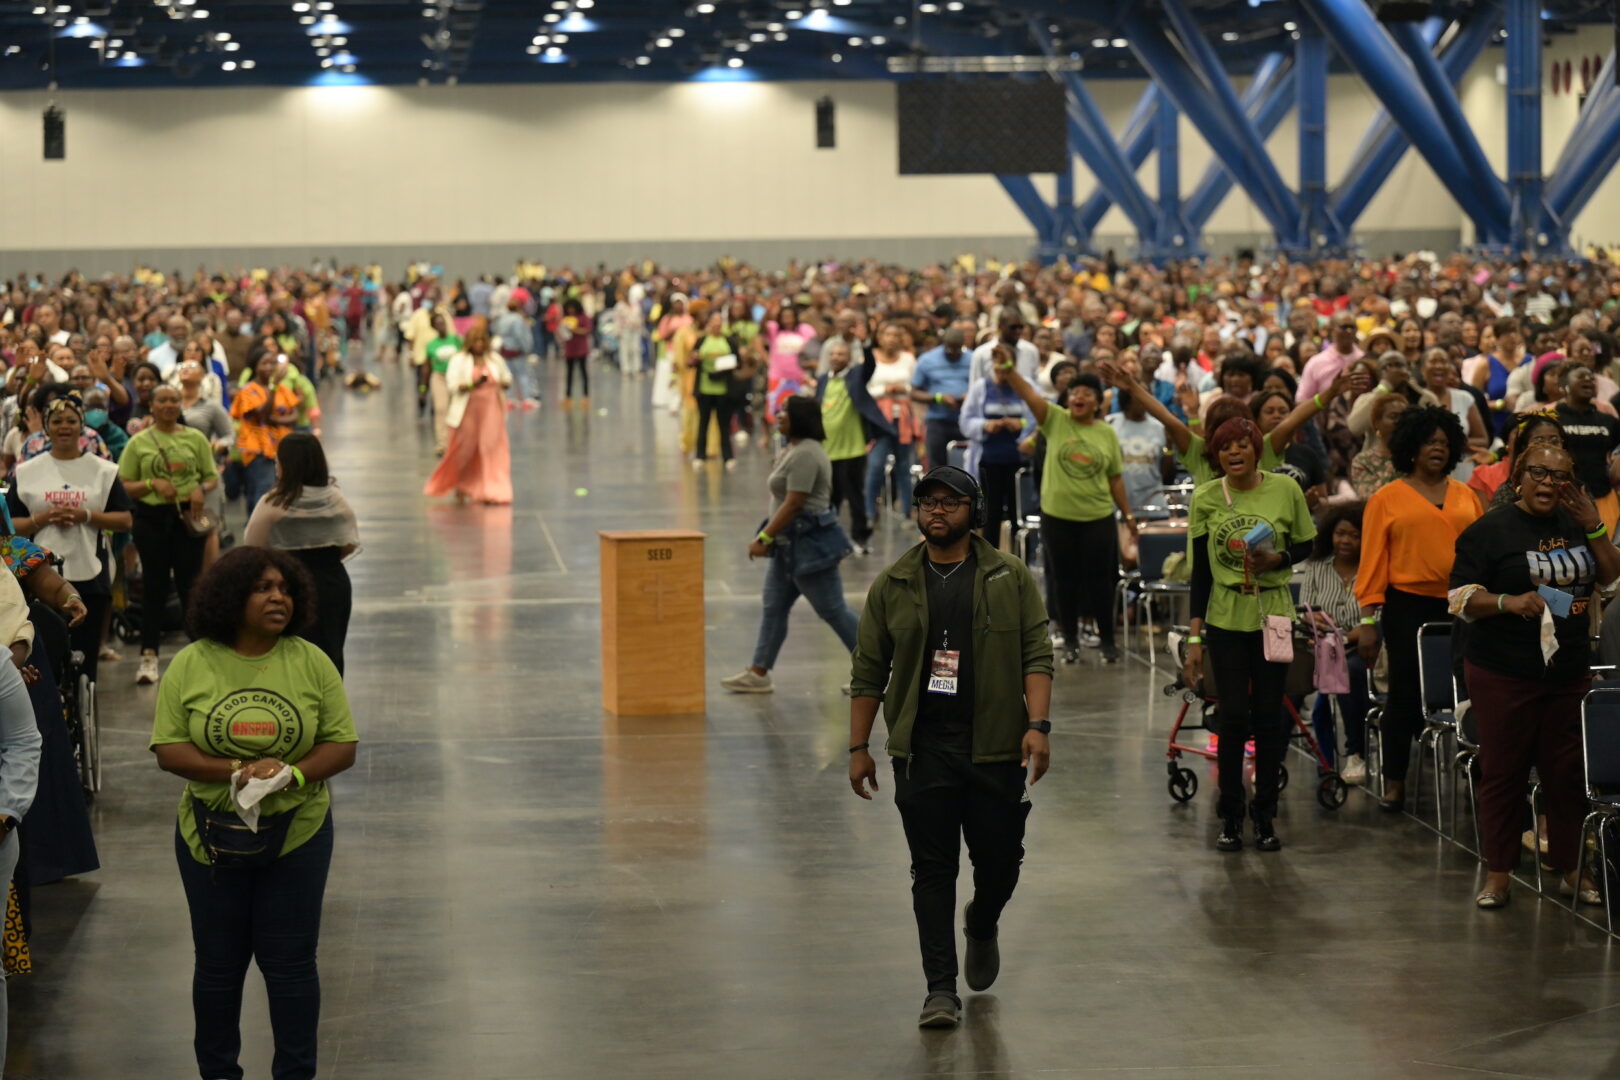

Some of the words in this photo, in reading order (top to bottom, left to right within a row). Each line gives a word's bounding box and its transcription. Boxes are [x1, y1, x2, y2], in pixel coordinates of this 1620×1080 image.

[45, 490, 87, 502] MEDICAL
[1538, 537, 1568, 552] What
[647, 548, 673, 561] SEED
[1526, 545, 1596, 586] GOD
[931, 679, 955, 691] MEDIA
[212, 711, 226, 745] WHAT
[224, 695, 248, 711] GOD
[252, 694, 294, 723] CANNOT
[283, 727, 295, 744] DO
